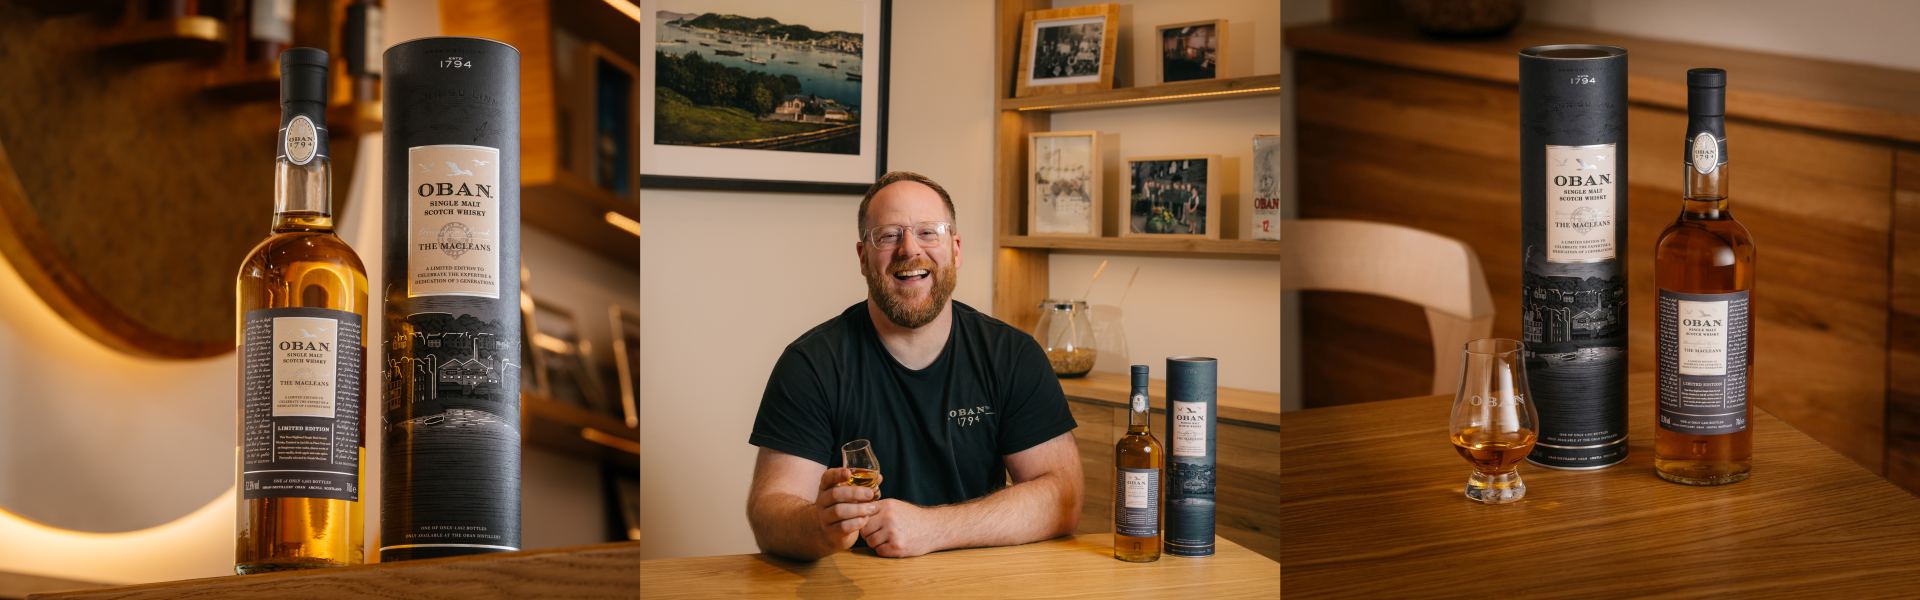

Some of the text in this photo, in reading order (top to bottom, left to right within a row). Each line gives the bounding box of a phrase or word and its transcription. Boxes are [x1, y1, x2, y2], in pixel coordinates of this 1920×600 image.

[440, 60, 472, 69] 1794
[1554, 174, 1611, 186] OBAN
[418, 182, 490, 198] OBAN
[1254, 198, 1279, 210] OBAN
[457, 209, 486, 217] WHISKY
[418, 242, 492, 252] THE MACLEANS
[279, 341, 330, 352] OBAN
[950, 406, 985, 418] OBAN
[958, 416, 980, 427] 1794
